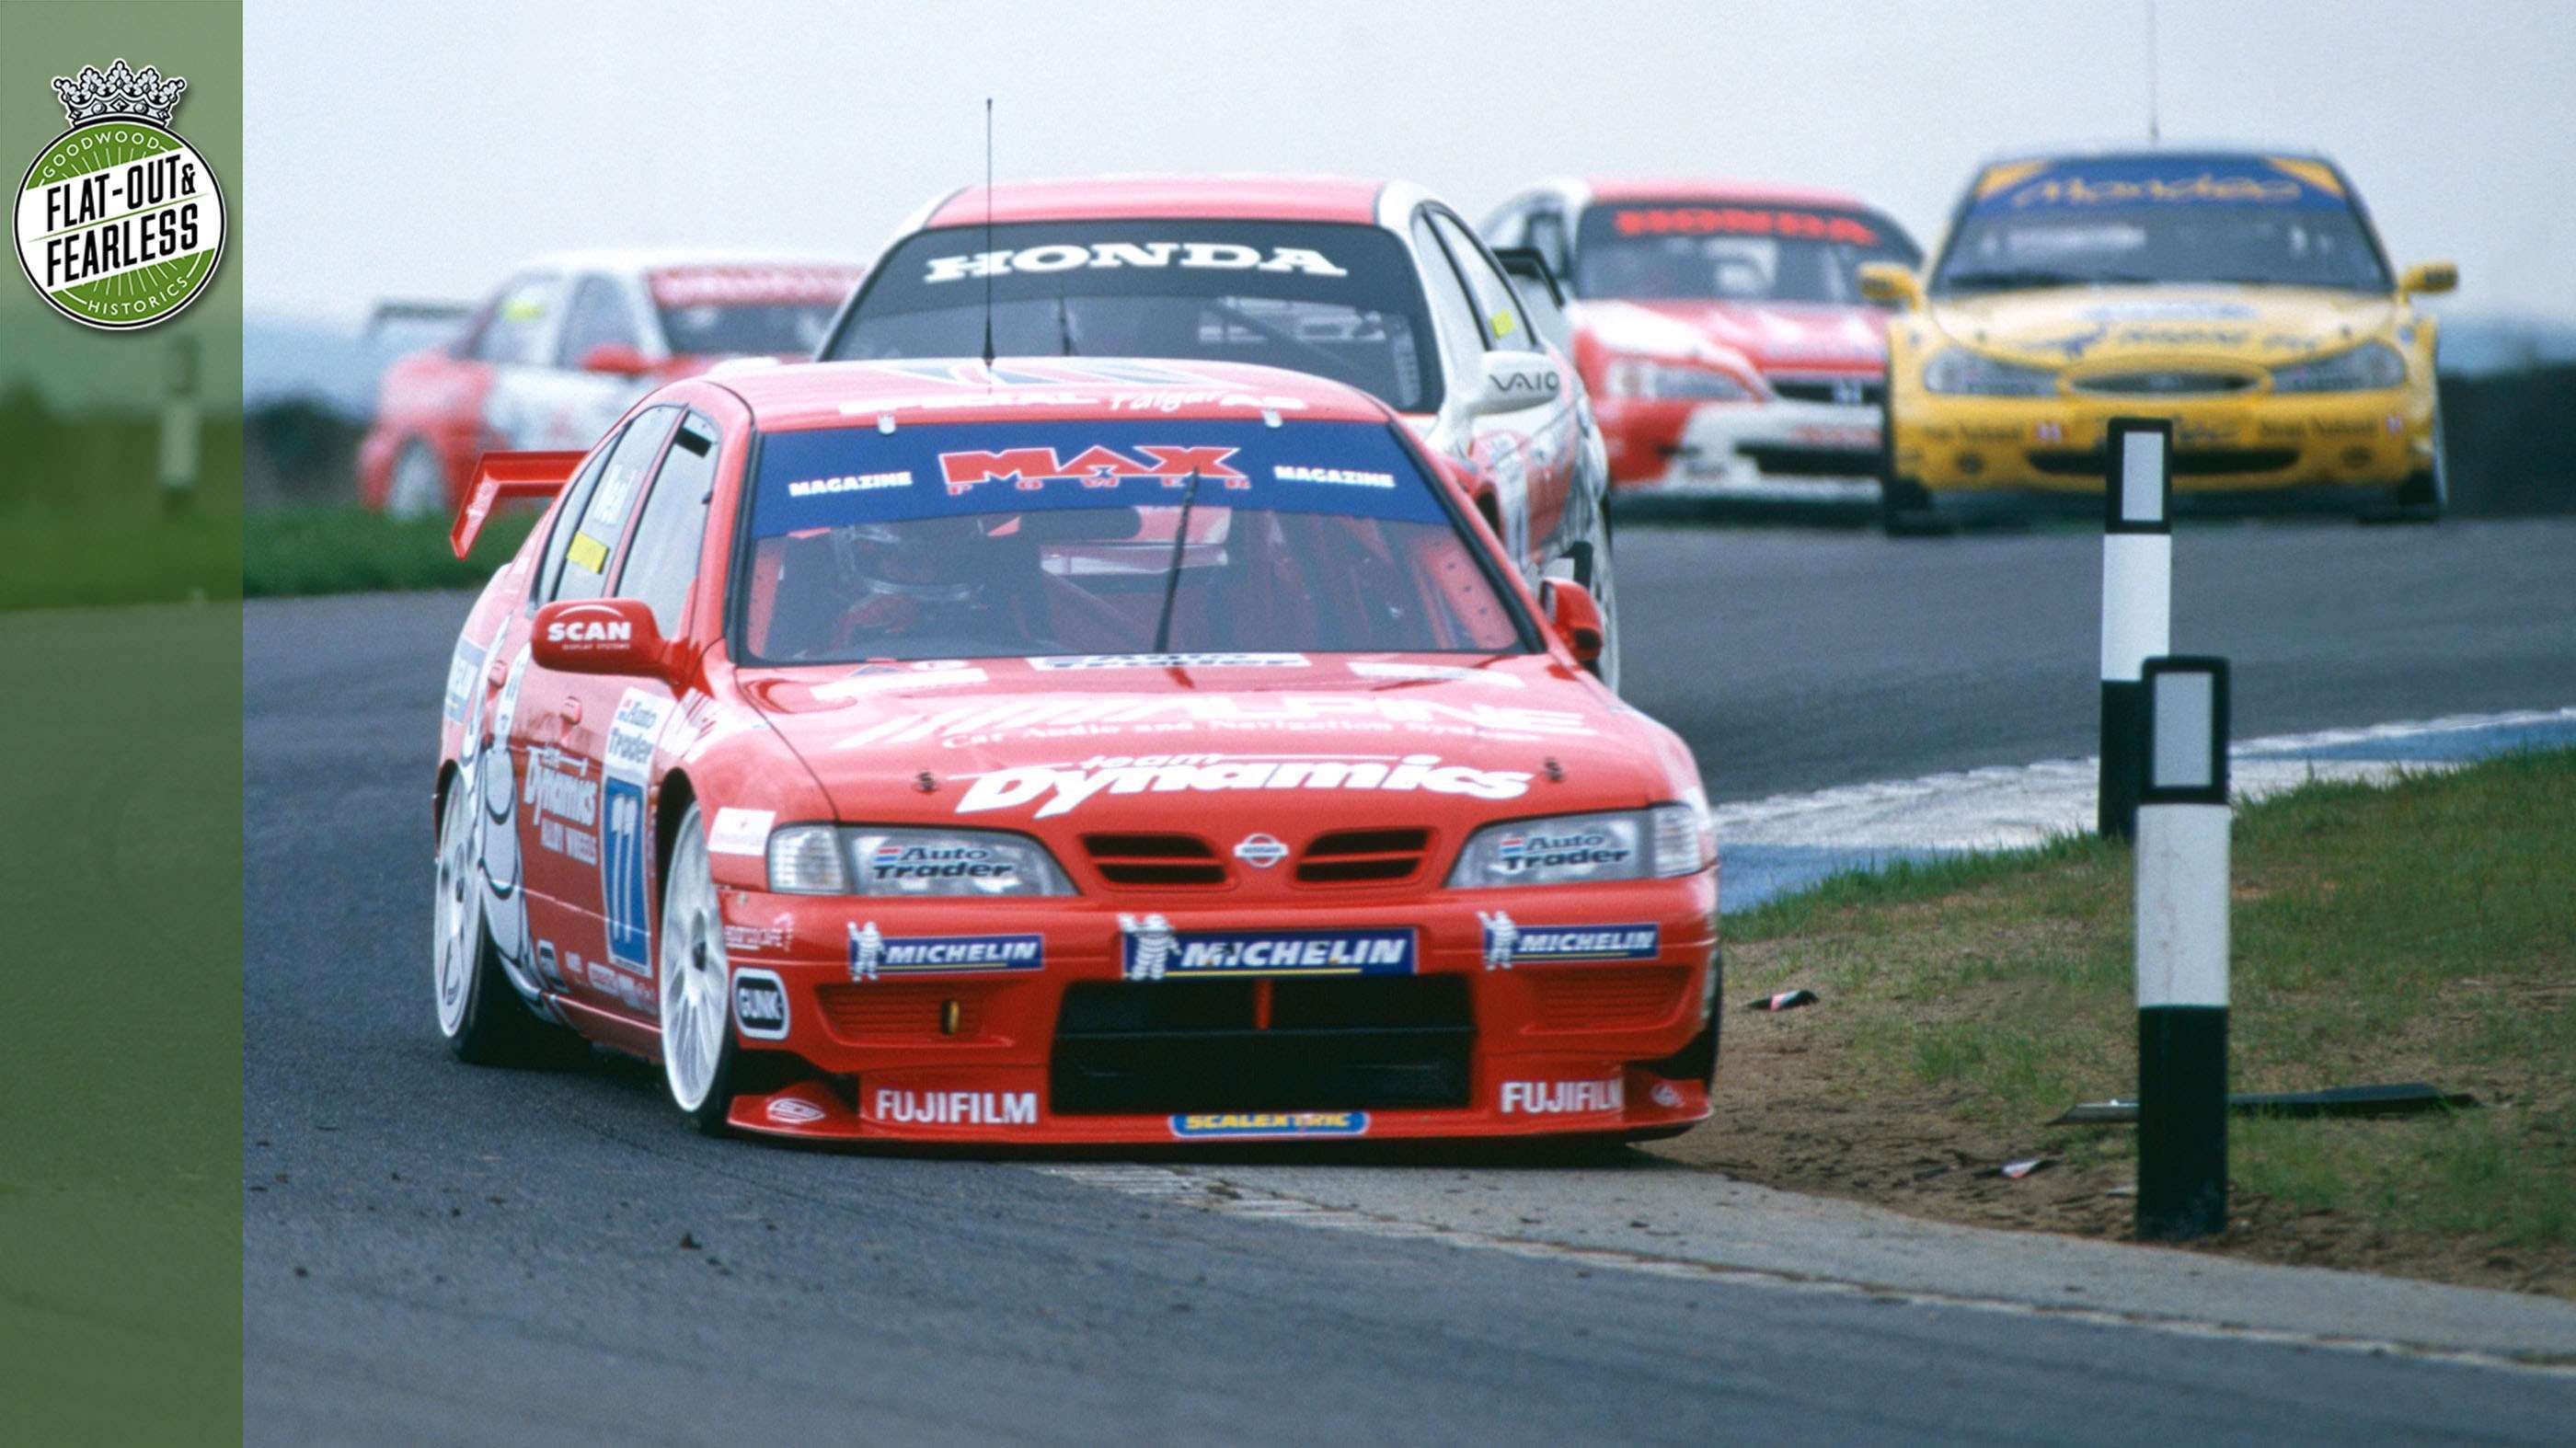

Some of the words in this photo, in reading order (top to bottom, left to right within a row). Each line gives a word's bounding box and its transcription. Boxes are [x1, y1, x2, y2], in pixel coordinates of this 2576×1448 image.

[924, 242, 1348, 282] HONDA
[1489, 370, 1560, 392] VAIO
[938, 444, 1248, 485] MAX
[788, 471, 913, 497] MAGAZINE
[1273, 465, 1396, 488] MAGAZINE
[547, 621, 632, 642] SCAN
[1133, 721, 1193, 733] and
[1079, 753, 1225, 776] team
[953, 754, 1537, 821] Dynamics
[901, 846, 988, 861] Auto
[1526, 834, 1604, 851] Auto
[1502, 847, 1629, 870] Trader
[873, 862, 1013, 879] Trader
[884, 941, 1039, 964] MICHELIN
[1180, 938, 1408, 966] MICHELIN
[1518, 930, 1656, 952] MICHELIN
[875, 1088, 1038, 1126] FUJIFILM
[1184, 1113, 1351, 1130] SCALEXTRIC
